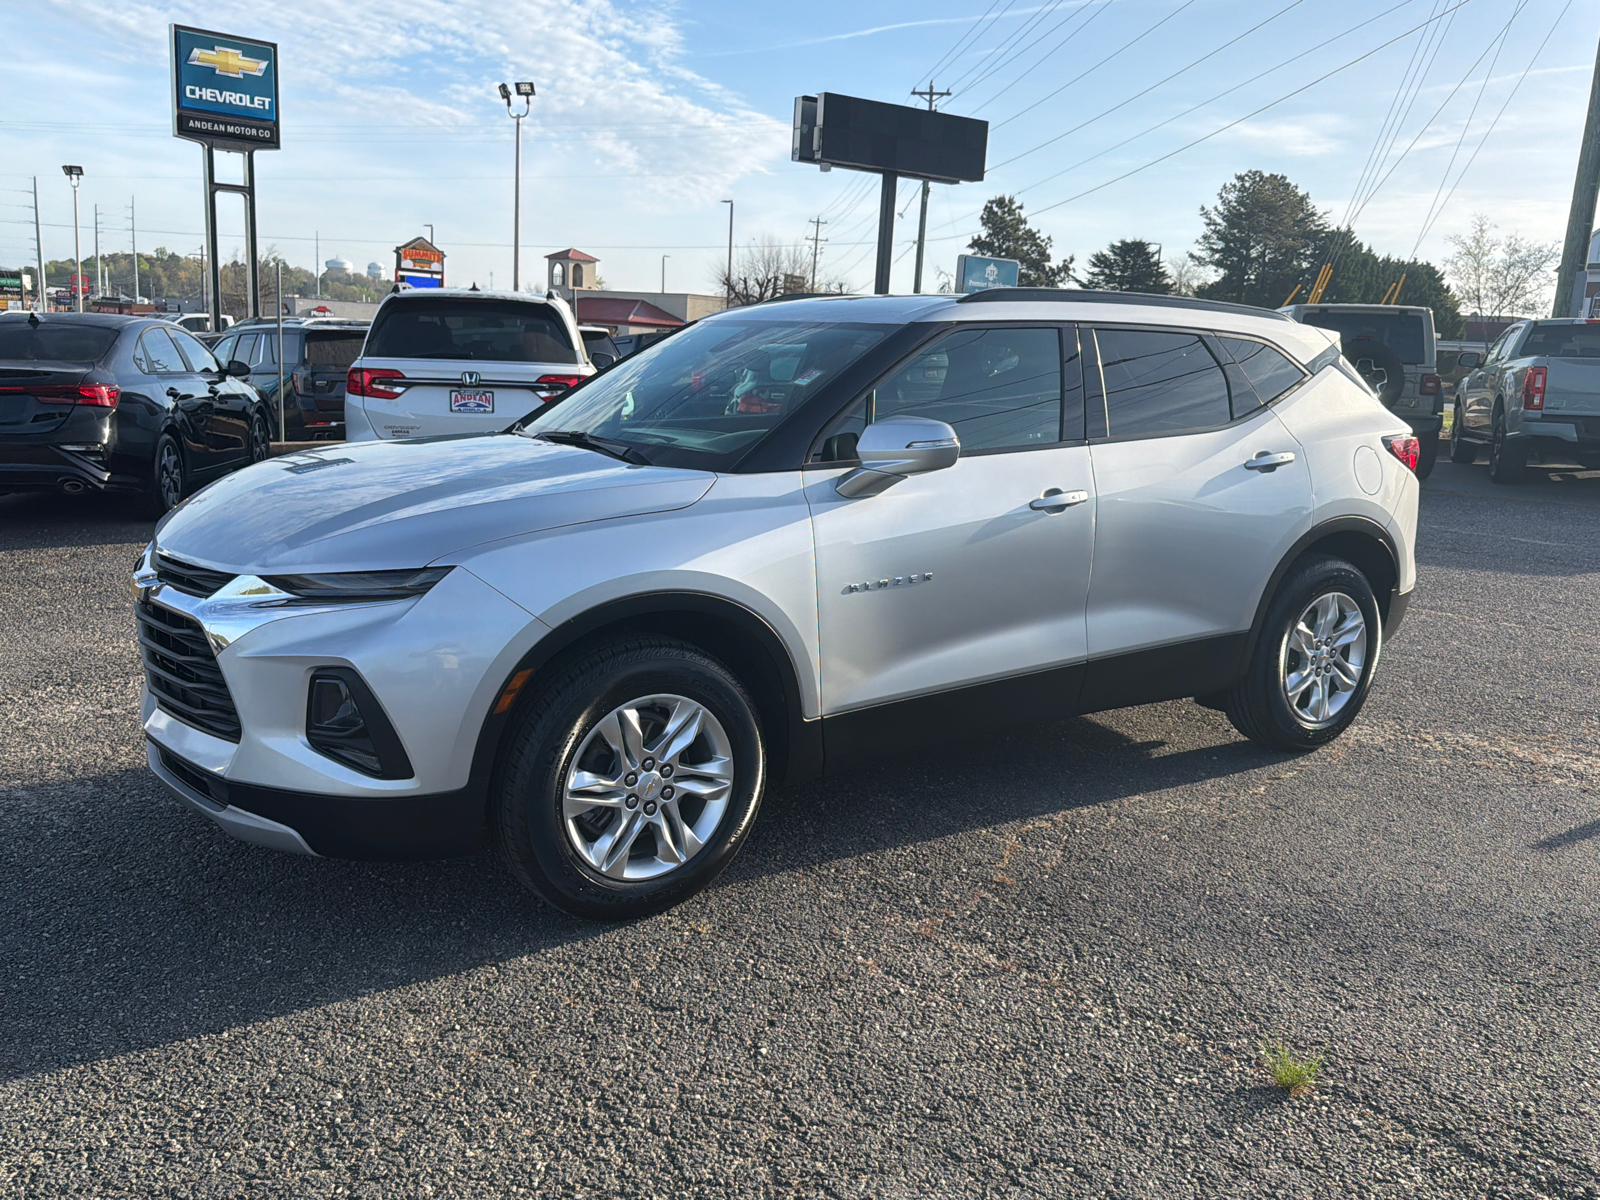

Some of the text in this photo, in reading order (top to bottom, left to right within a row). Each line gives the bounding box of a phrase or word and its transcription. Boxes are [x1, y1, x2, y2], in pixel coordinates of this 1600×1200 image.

[185, 85, 272, 110] CHEVROLET
[188, 119, 271, 138] ANDEAN MOTOR CO
[968, 279, 987, 288] Premier
[453, 393, 491, 406] ANDEAN
[848, 572, 934, 593] BLAZER
